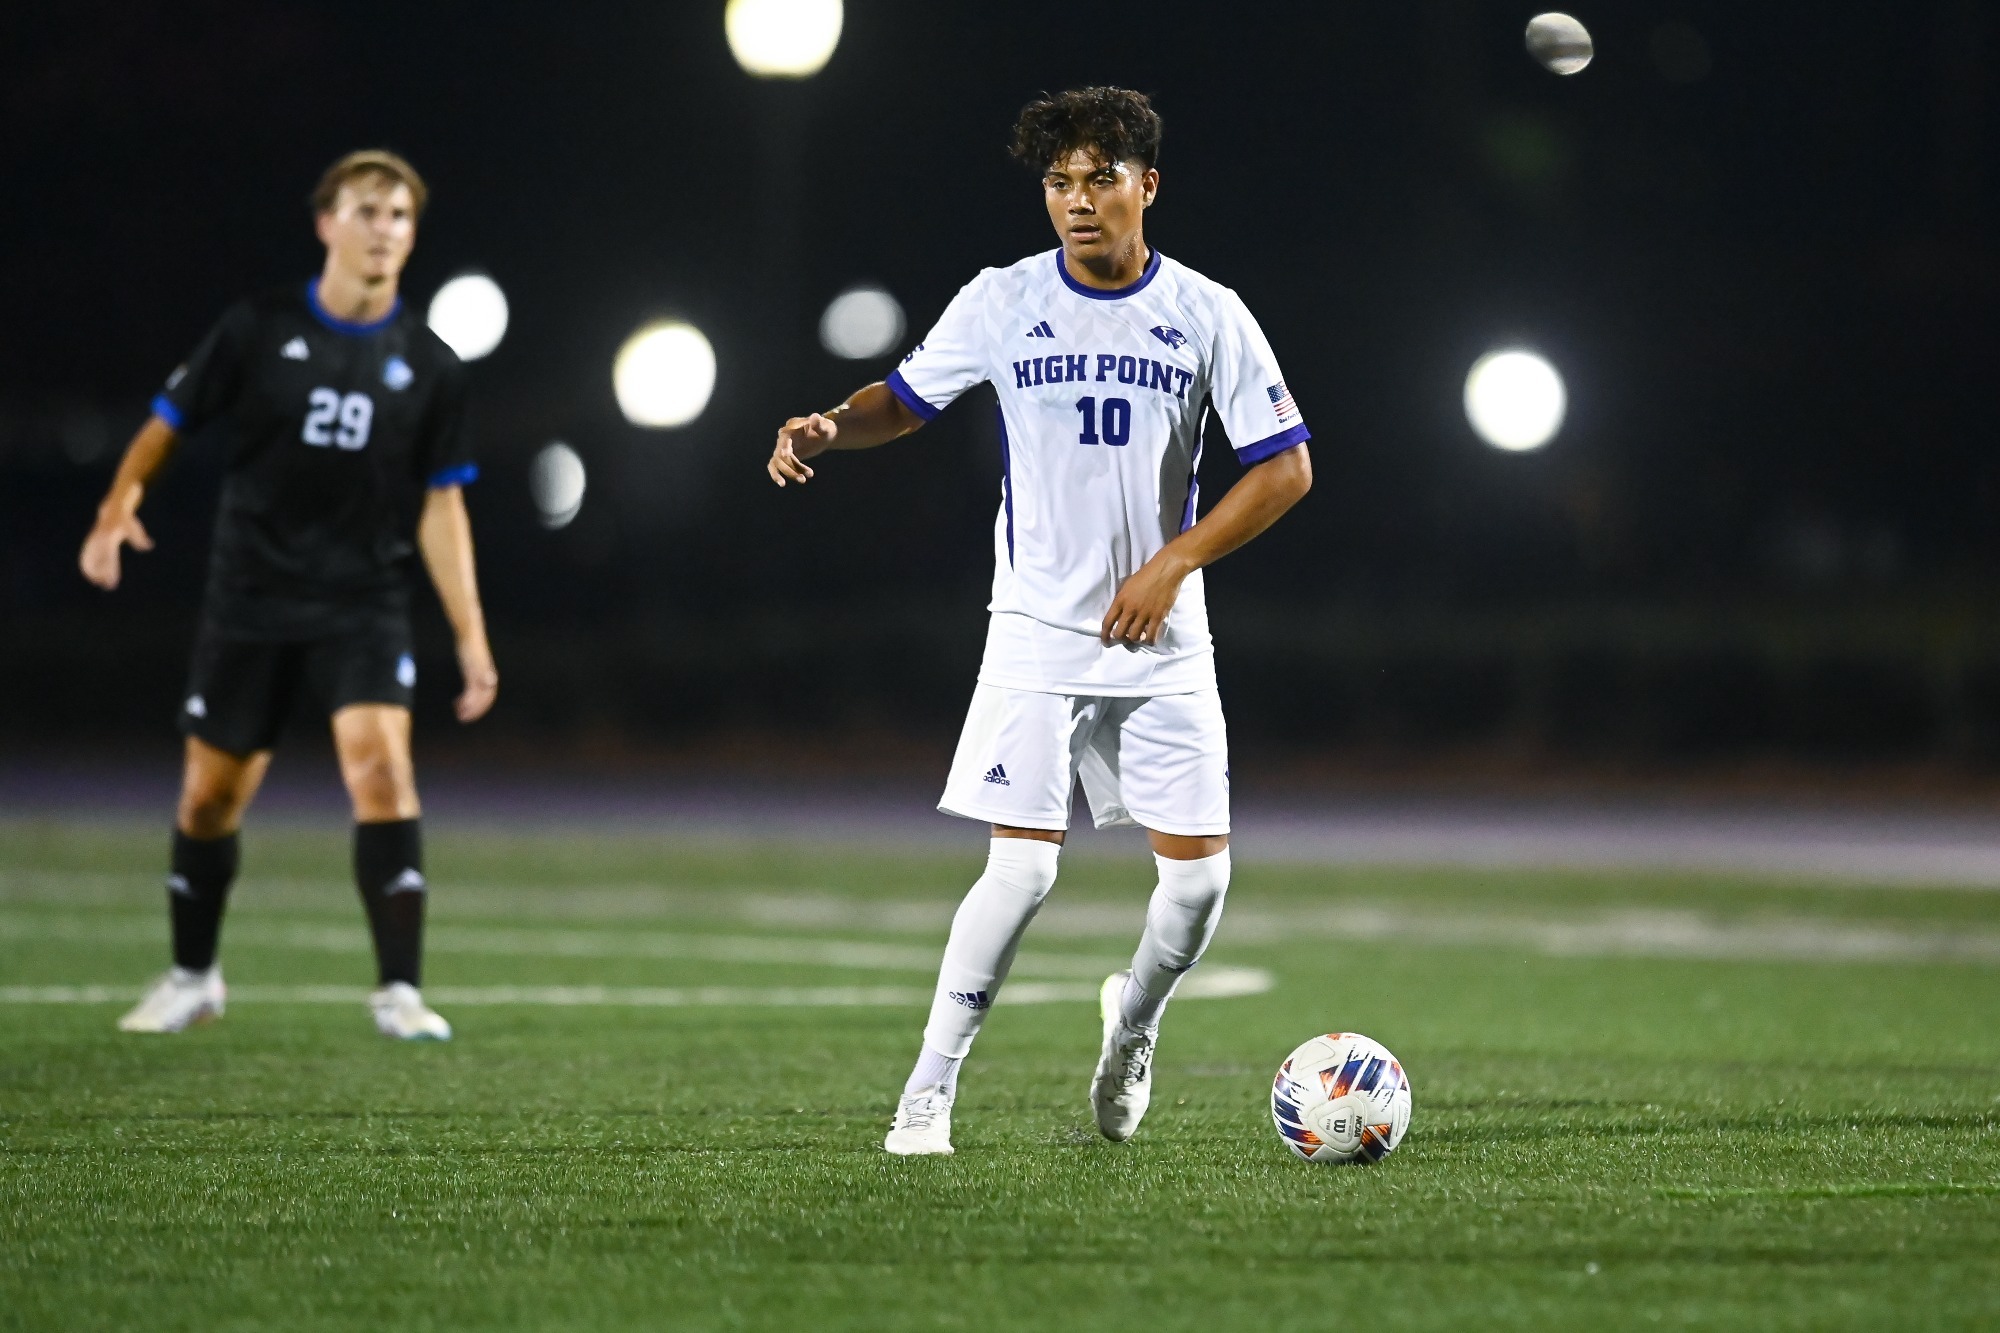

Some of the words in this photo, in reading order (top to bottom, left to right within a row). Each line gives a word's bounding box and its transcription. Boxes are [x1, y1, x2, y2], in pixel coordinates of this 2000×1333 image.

[1012, 355, 1088, 389] HIGH
[1095, 354, 1194, 400] POINT
[302, 386, 374, 450] 29
[1076, 396, 1131, 446] 10
[983, 775, 1010, 786] adidas
[1354, 1115, 1363, 1137] NCAA
